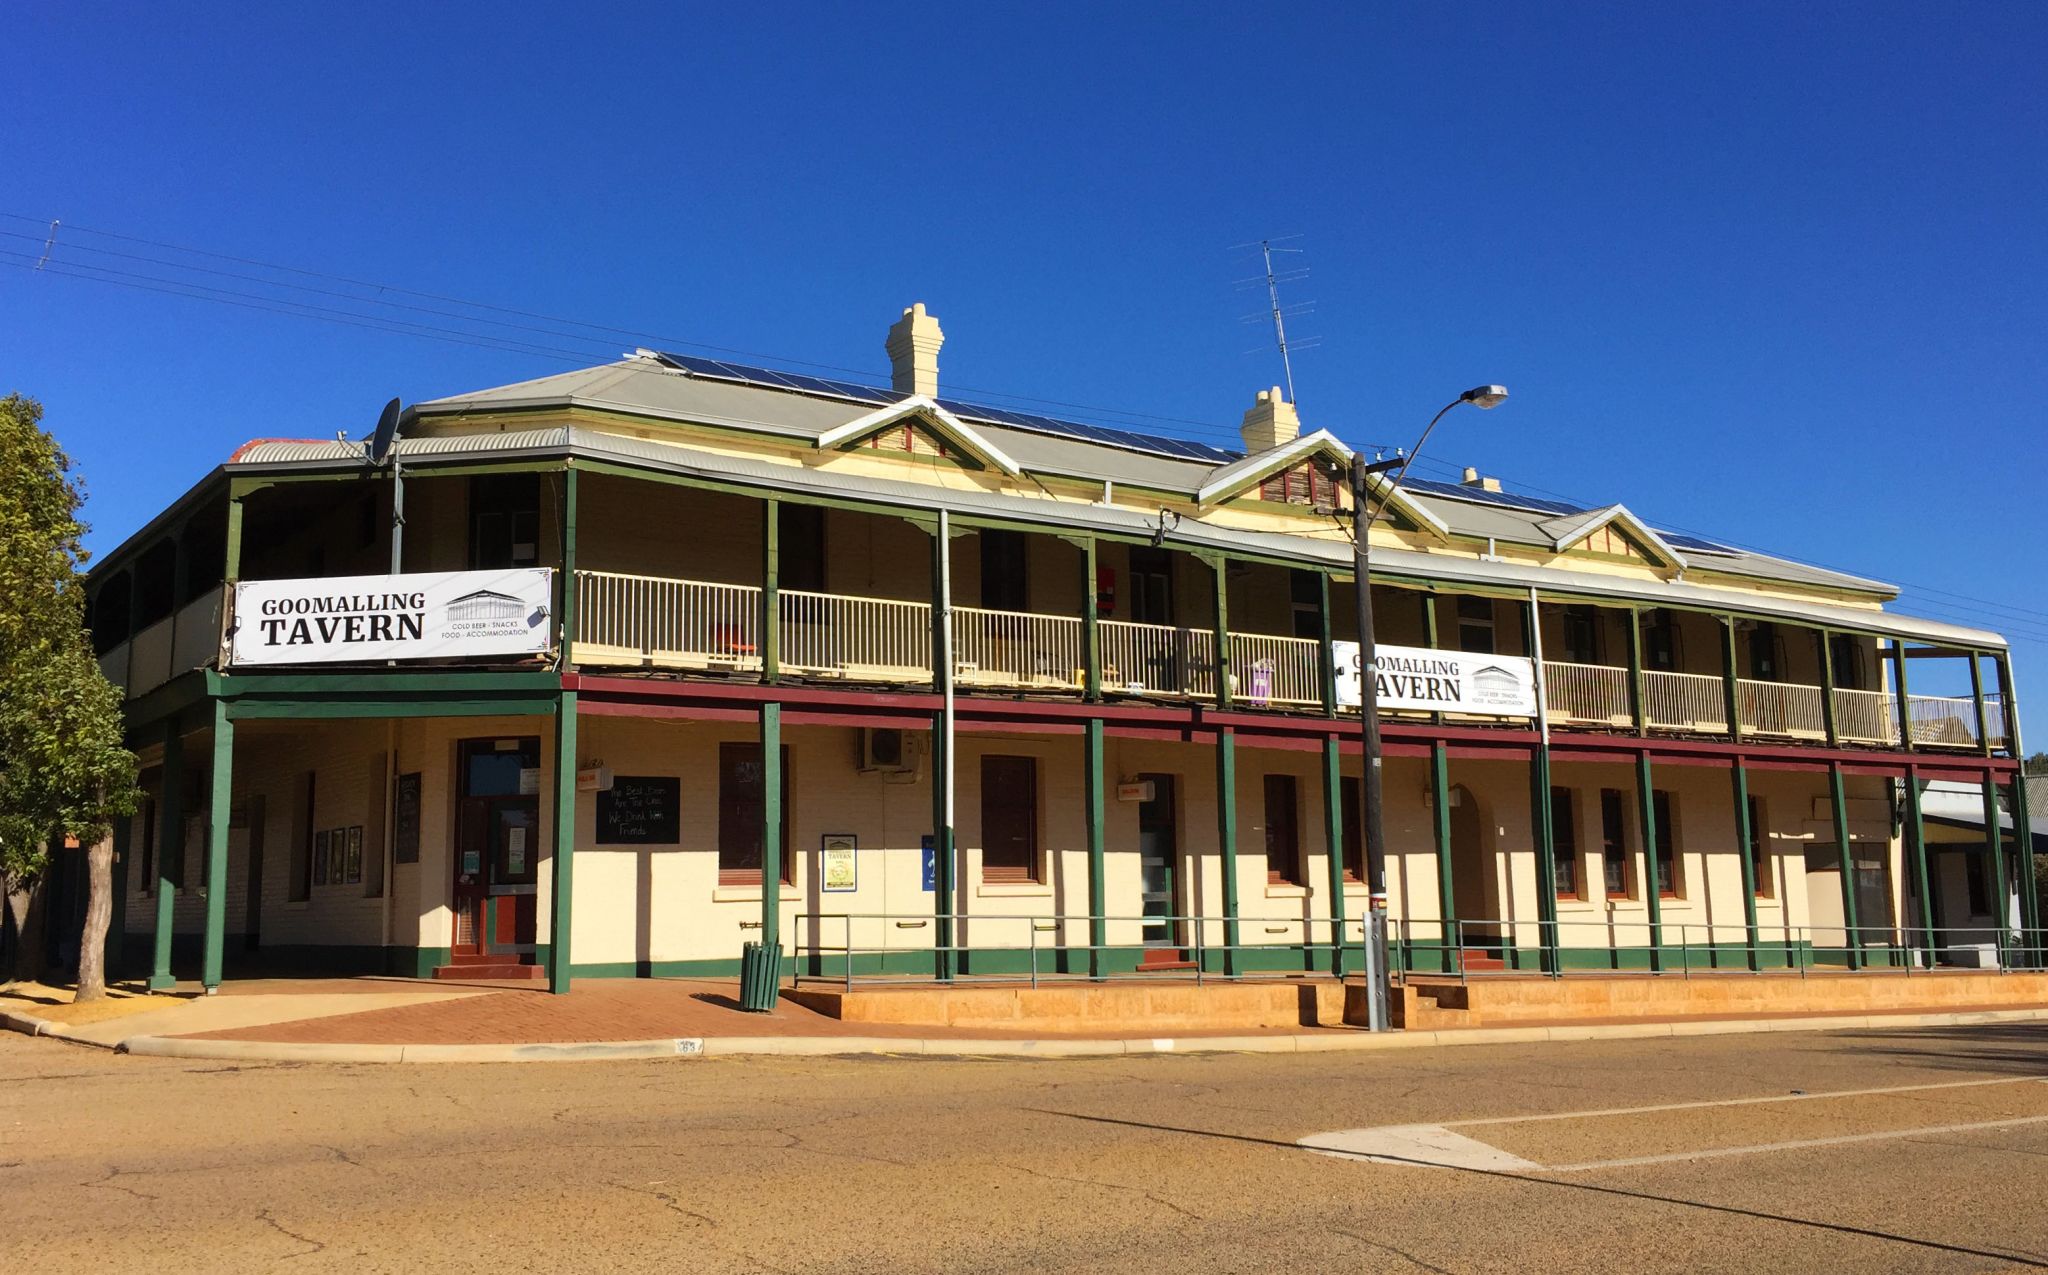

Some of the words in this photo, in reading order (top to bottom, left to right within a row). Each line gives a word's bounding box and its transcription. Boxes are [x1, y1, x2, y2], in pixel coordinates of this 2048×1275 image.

[261, 592, 426, 616] GOOMALLING
[260, 613, 426, 646] TAVERN
[441, 631, 461, 639] FOOD
[466, 629, 529, 638] ACCOMMODATION
[1352, 654, 1460, 676] GOMALLING
